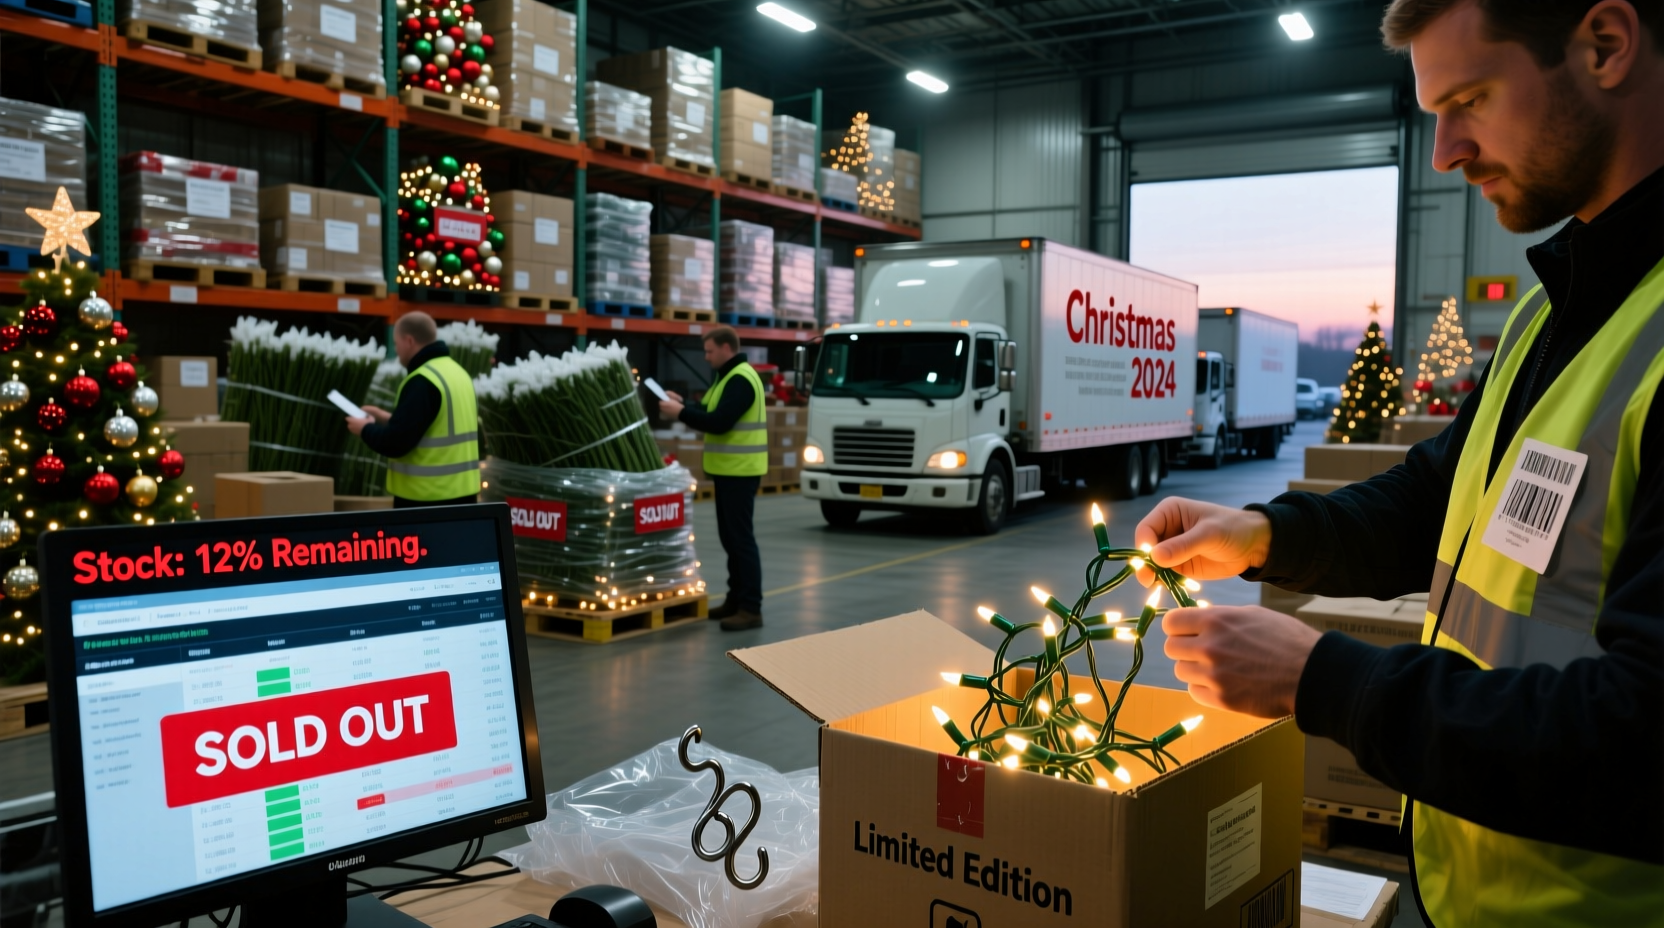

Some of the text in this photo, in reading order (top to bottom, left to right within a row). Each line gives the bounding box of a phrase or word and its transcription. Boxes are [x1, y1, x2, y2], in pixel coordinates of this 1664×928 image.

[1066, 289, 1176, 352] Christmas
[1130, 356, 1177, 399] 2024
[73, 530, 428, 585] Stock: 12% Remaining.
[195, 714, 328, 777] SOLD
[339, 694, 430, 747] OUT
[853, 819, 1073, 917] Limited Edition
